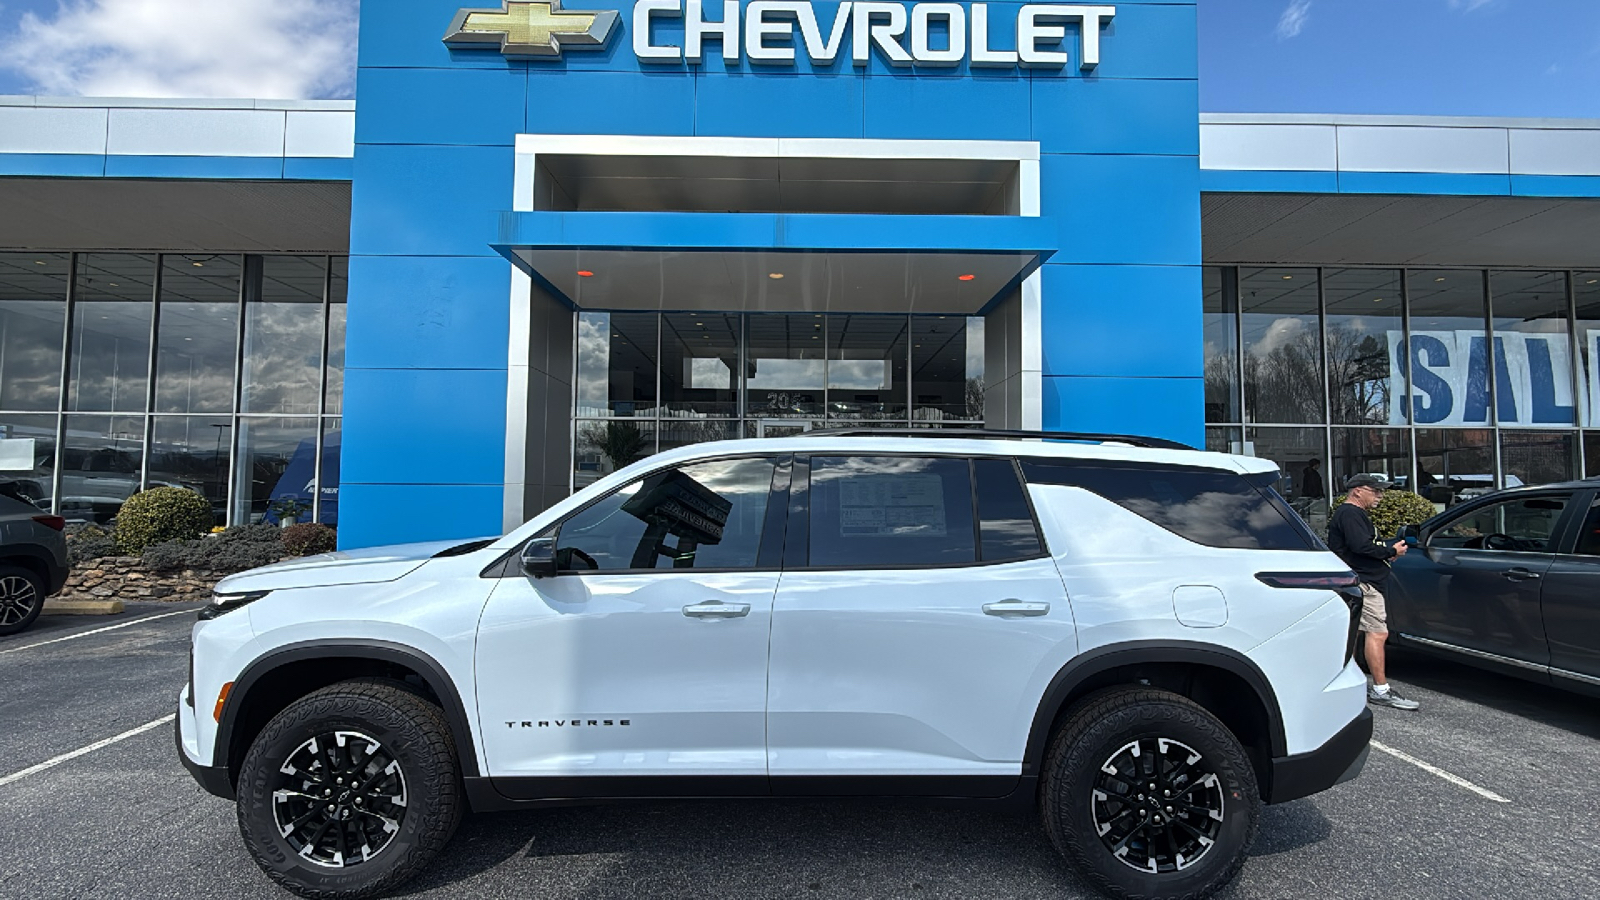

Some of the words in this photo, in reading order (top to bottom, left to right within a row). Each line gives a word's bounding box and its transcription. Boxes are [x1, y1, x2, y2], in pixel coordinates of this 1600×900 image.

[632, 0, 1115, 70] CHEVROLET
[1396, 334, 1600, 423] SAL
[505, 719, 631, 728] TRAVERSE
